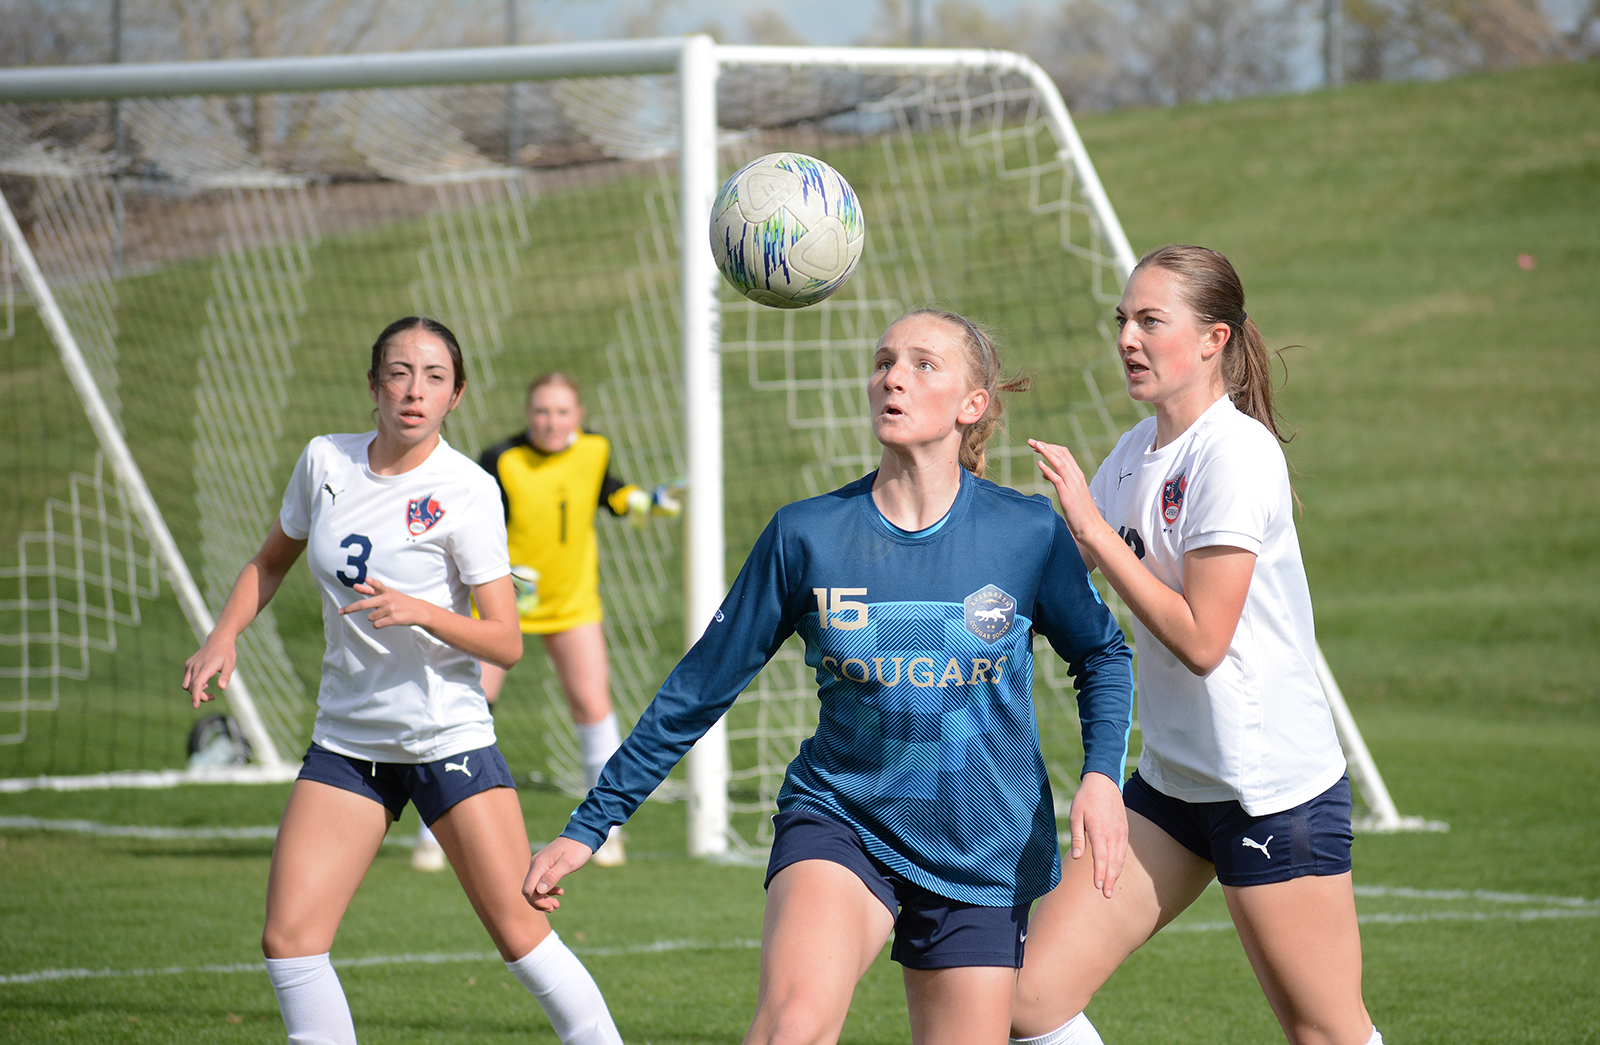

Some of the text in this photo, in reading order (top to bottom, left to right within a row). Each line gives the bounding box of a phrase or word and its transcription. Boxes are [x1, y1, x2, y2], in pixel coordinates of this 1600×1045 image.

[558, 501, 567, 544] 1
[336, 533, 373, 588] 3
[812, 587, 869, 631] 15
[970, 591, 1011, 607] EVERGREEN
[969, 620, 1011, 640] COUGAR SOCCER
[822, 656, 1008, 687] COUGARS
